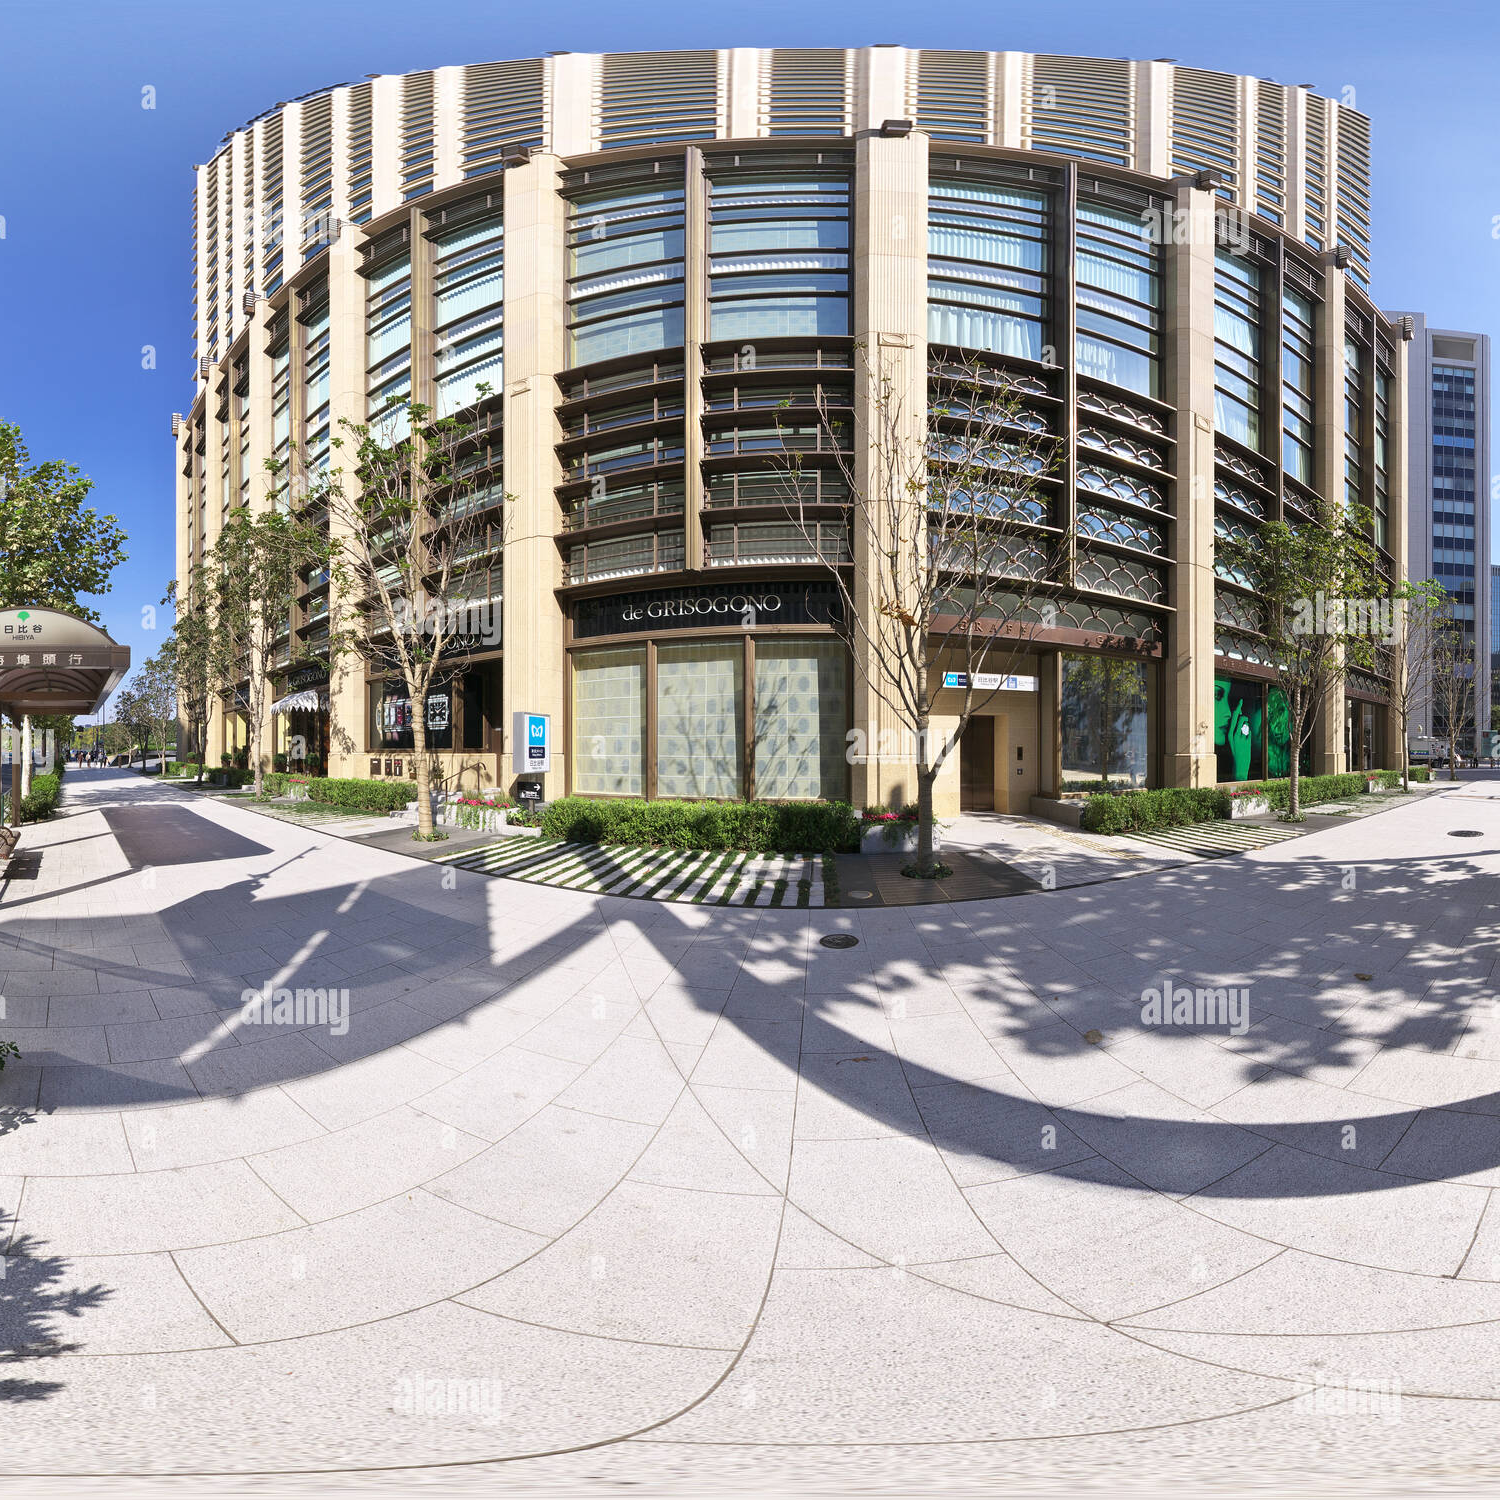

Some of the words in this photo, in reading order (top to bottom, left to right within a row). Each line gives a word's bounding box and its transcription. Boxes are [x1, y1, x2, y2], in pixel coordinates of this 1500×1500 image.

[622, 604, 644, 621] de
[647, 594, 781, 619] GRISOGONO
[4, 624, 42, 634] 日比谷
[958, 619, 1027, 636] GRAFF
